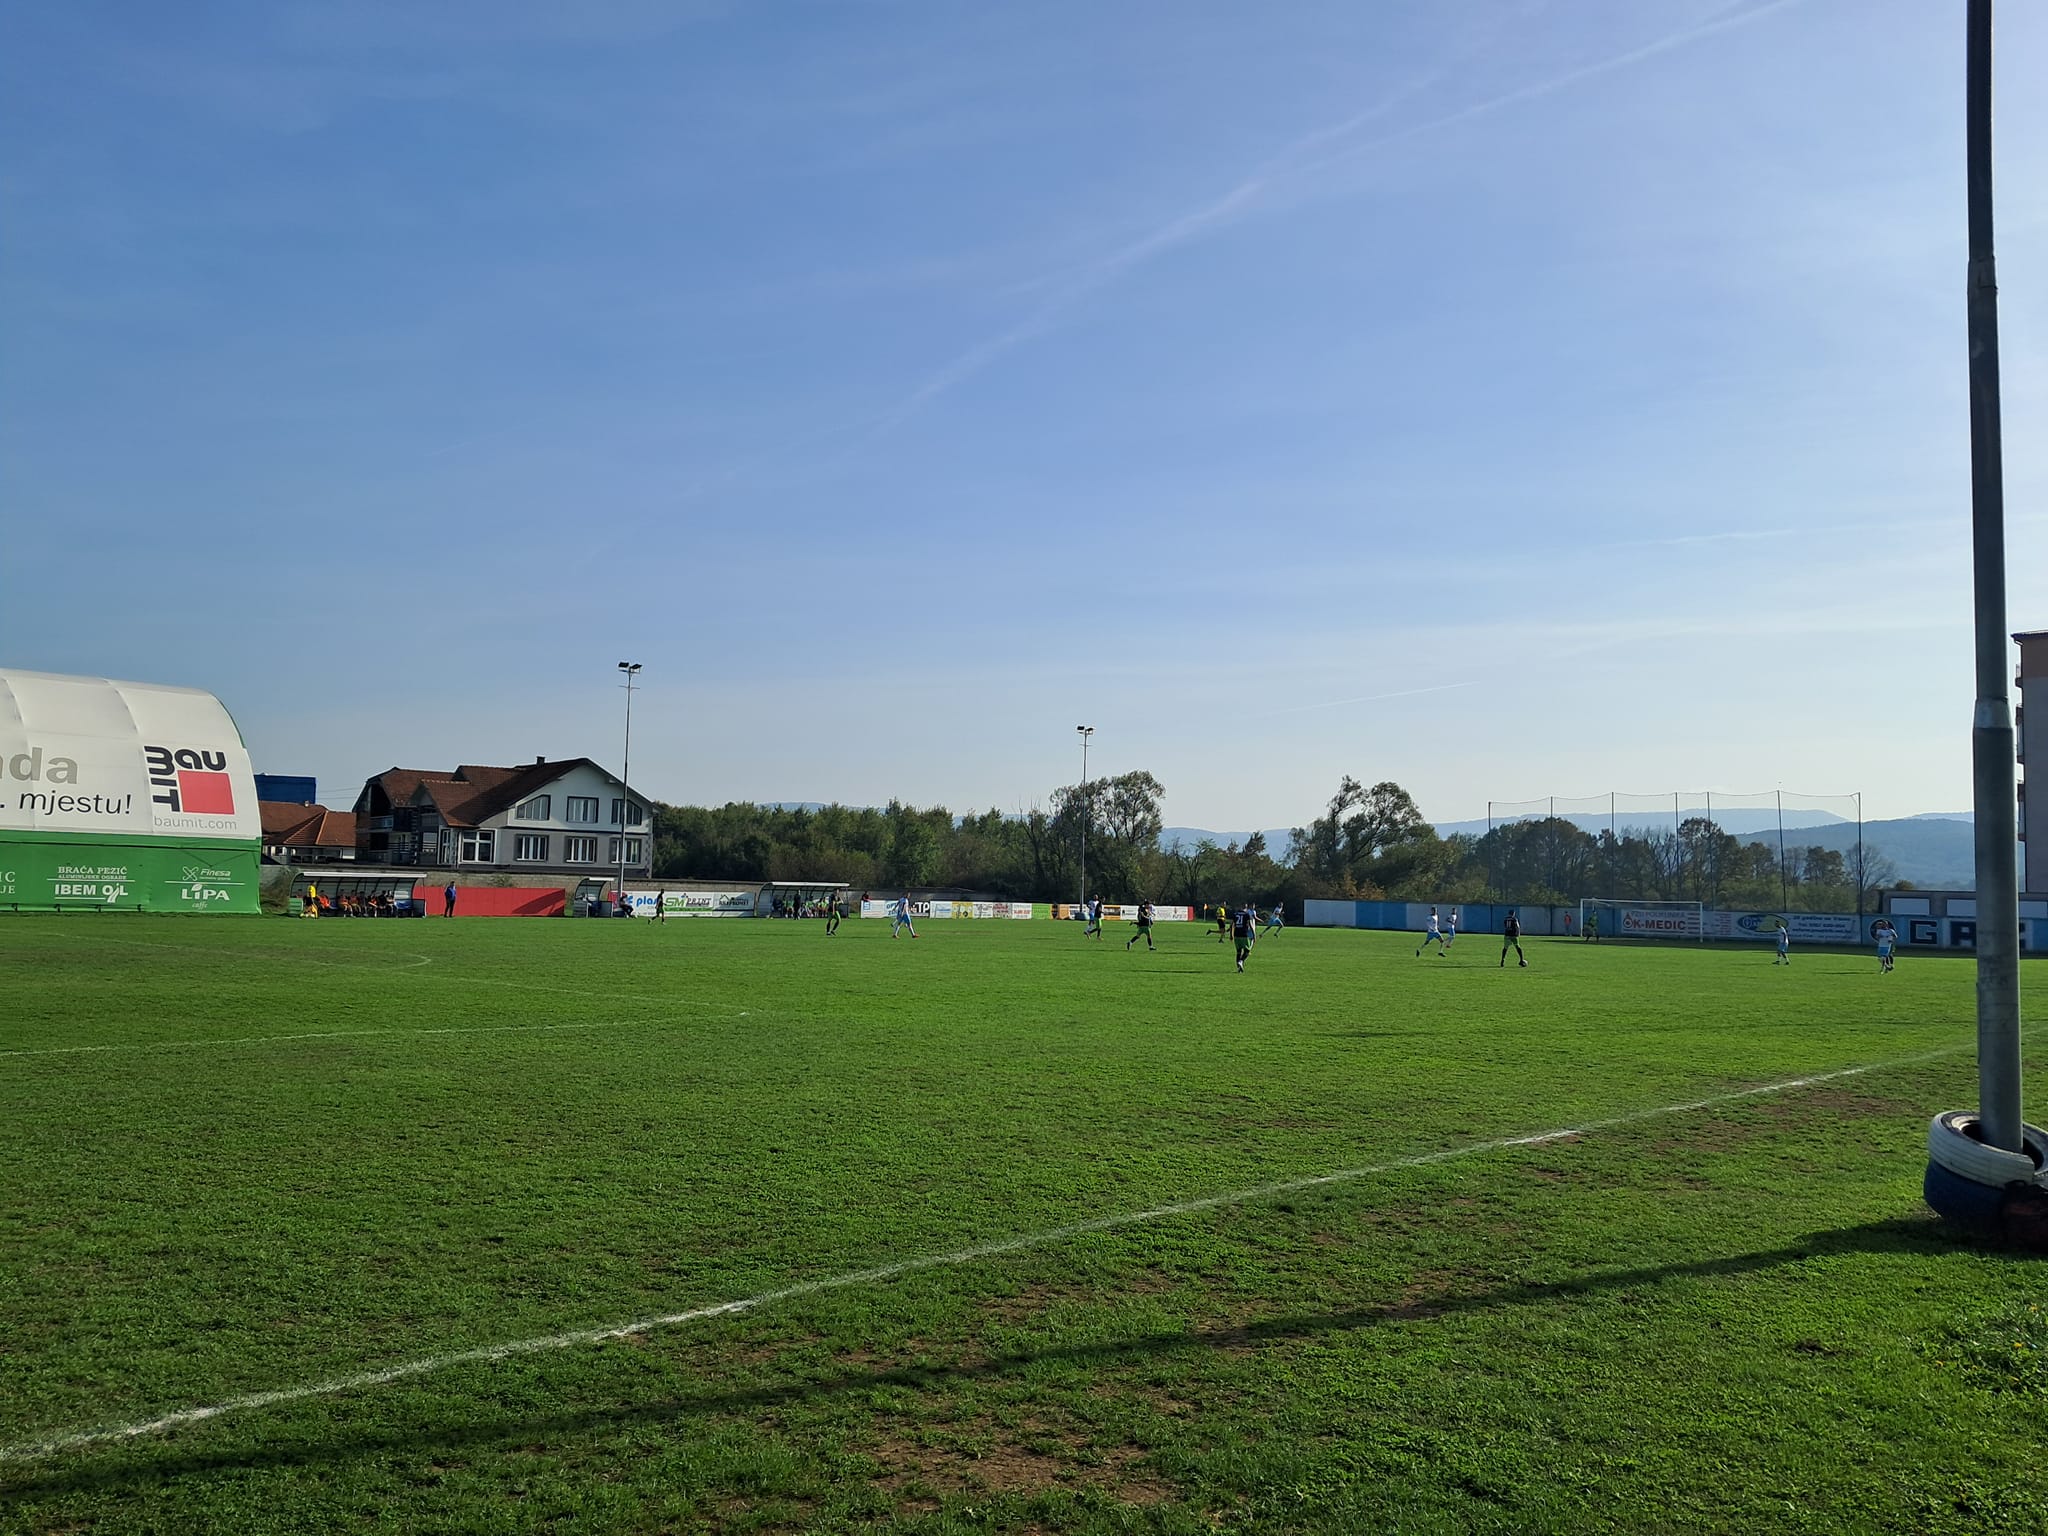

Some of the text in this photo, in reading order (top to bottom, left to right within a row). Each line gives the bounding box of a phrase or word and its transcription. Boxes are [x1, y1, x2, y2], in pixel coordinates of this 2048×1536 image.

[19, 789, 132, 816] mjestu!
[154, 815, 238, 830] baumit.com
[54, 884, 97, 896] IBEM
